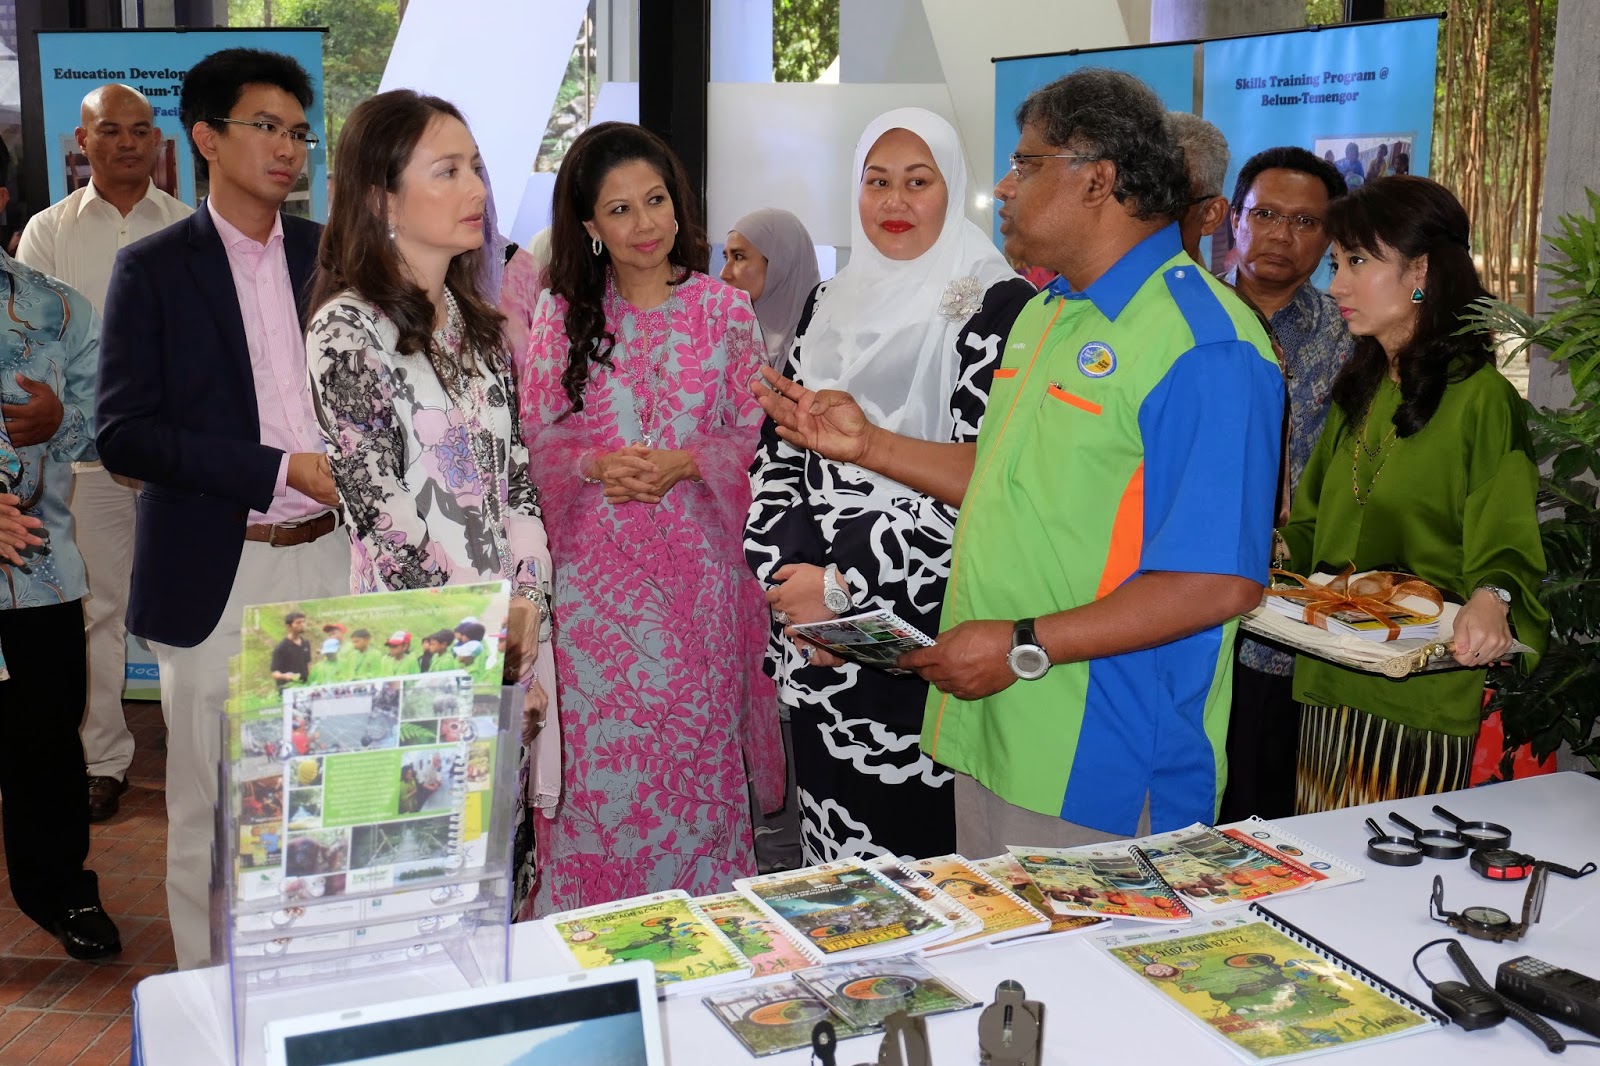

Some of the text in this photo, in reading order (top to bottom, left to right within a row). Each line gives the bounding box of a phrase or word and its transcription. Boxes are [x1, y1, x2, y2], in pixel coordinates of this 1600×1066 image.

[54, 68, 187, 81] Education Develop
[1236, 67, 1389, 90] Skills Training Program @
[1261, 91, 1359, 107] Belum-Temengor
[1187, 942, 1213, 953] NOV
[1211, 935, 1249, 948] 24-28
[1156, 946, 1188, 957] 2014
